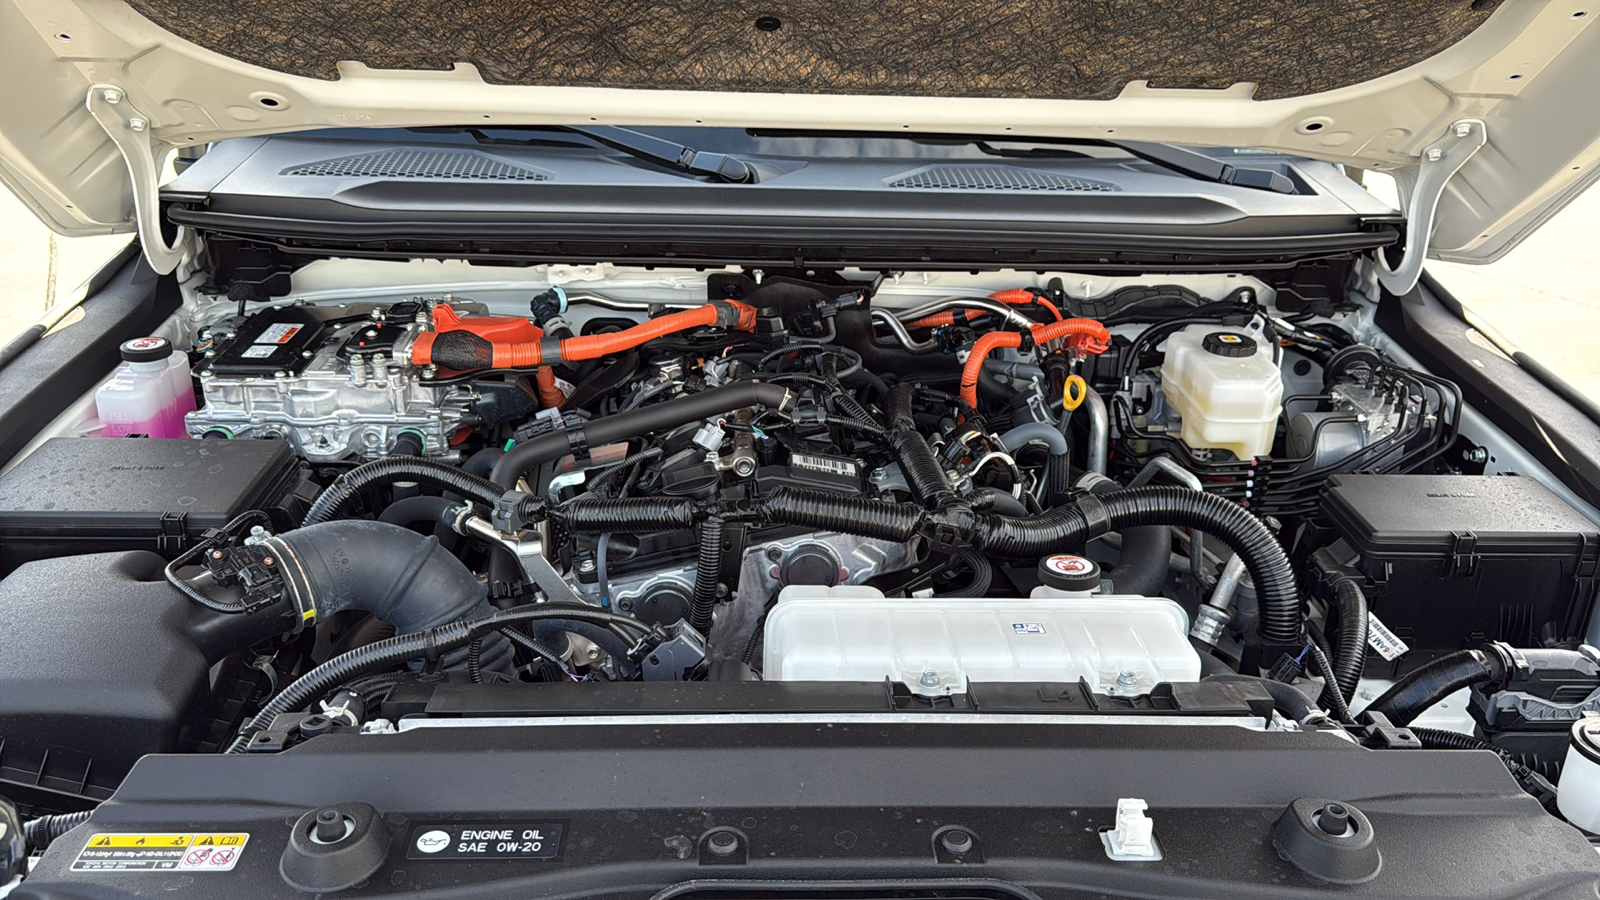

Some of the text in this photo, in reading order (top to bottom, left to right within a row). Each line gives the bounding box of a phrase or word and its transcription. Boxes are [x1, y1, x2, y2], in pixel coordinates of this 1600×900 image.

[460, 830, 544, 840] ENGINE OIL
[457, 842, 542, 853] SAE 0W-20
